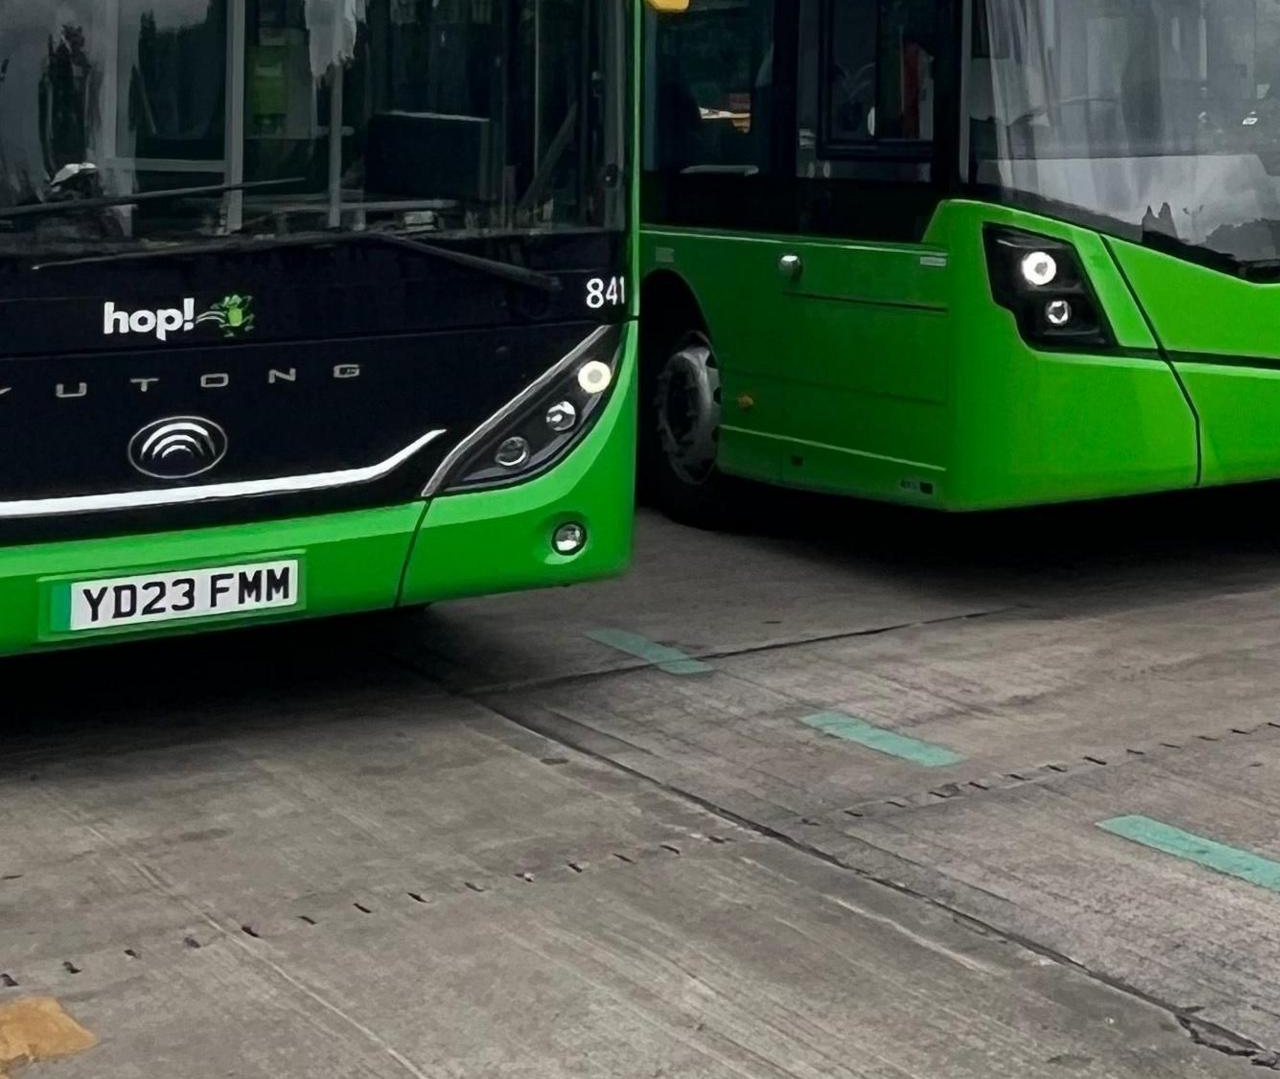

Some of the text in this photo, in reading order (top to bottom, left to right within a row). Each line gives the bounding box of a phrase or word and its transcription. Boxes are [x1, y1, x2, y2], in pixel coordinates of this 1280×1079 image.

[586, 276, 625, 308] 841
[103, 298, 195, 341] hop!
[82, 566, 290, 622] YD23 FMM
